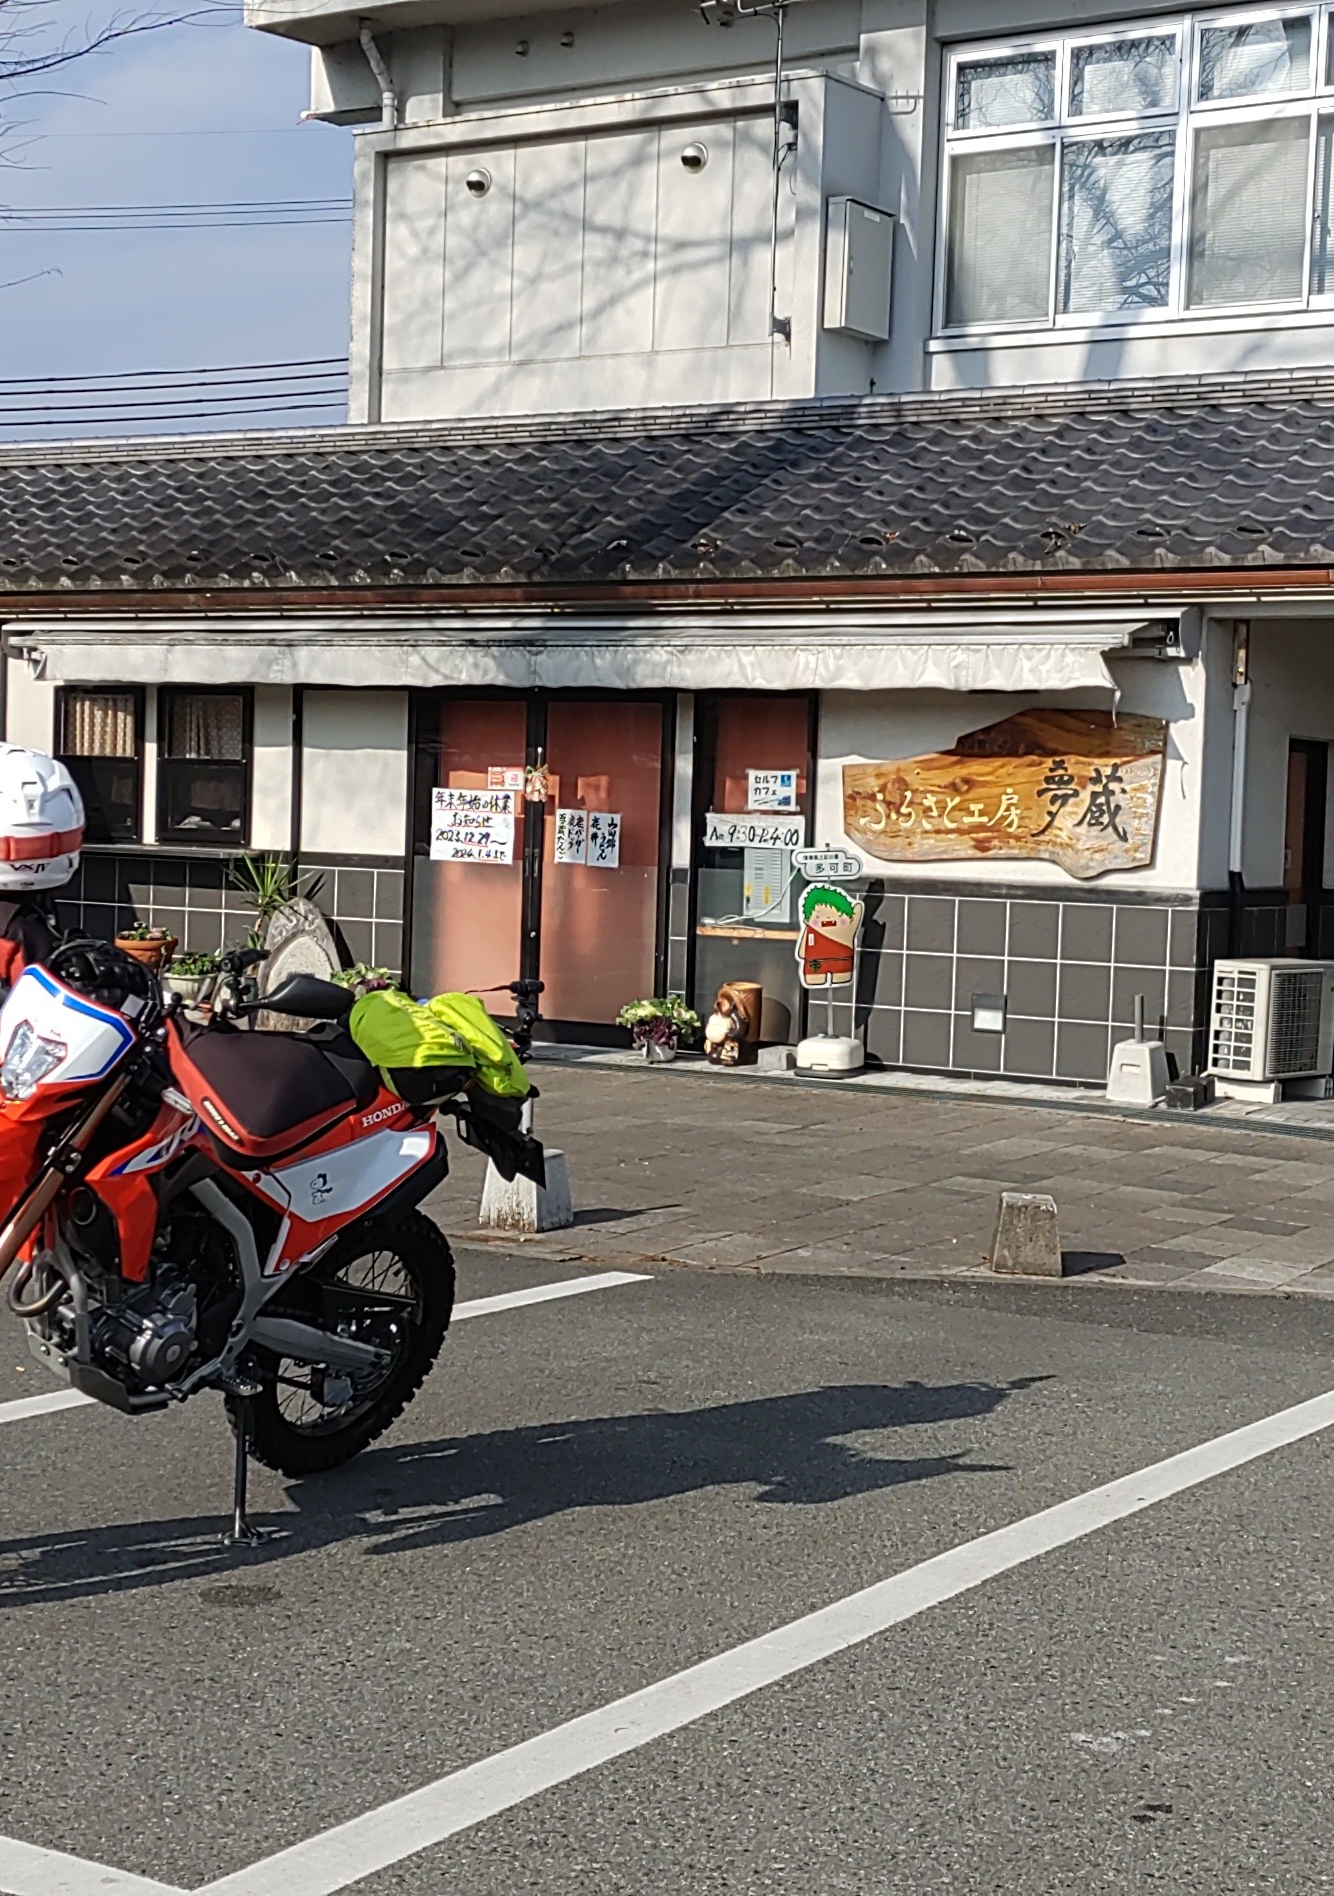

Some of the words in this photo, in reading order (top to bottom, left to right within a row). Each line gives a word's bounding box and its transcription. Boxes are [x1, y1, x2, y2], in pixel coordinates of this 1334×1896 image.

[753, 774, 779, 784] セルフ
[753, 786, 778, 796] カフェ
[1031, 758, 1129, 843] 夢蔵
[815, 861, 854, 874] 多可町
